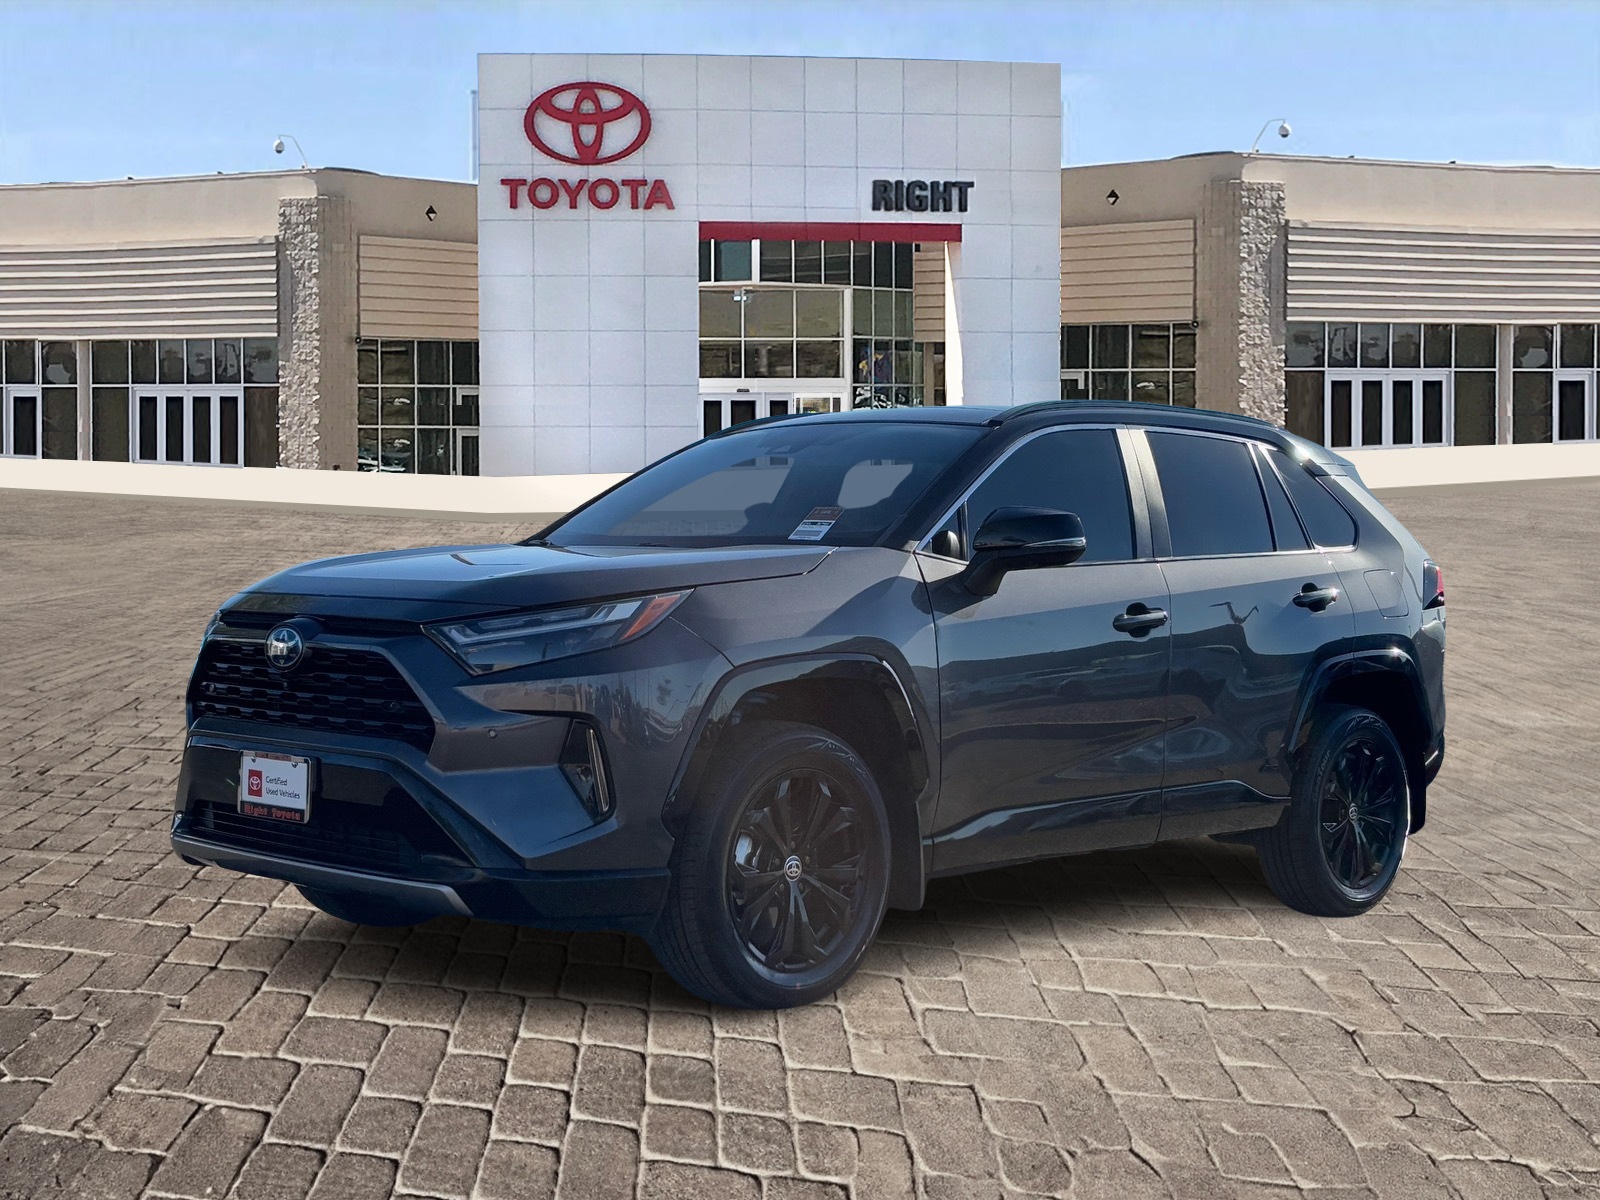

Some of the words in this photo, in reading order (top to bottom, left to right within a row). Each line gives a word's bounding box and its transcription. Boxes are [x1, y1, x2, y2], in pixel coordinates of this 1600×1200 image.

[500, 178, 675, 209] TOYOTA
[872, 179, 975, 212] RIGHT
[265, 775, 288, 786] Certified
[265, 786, 279, 796] Used
[279, 789, 301, 800] Vehicles
[244, 802, 268, 816] Right
[271, 808, 301, 821] Toyota
